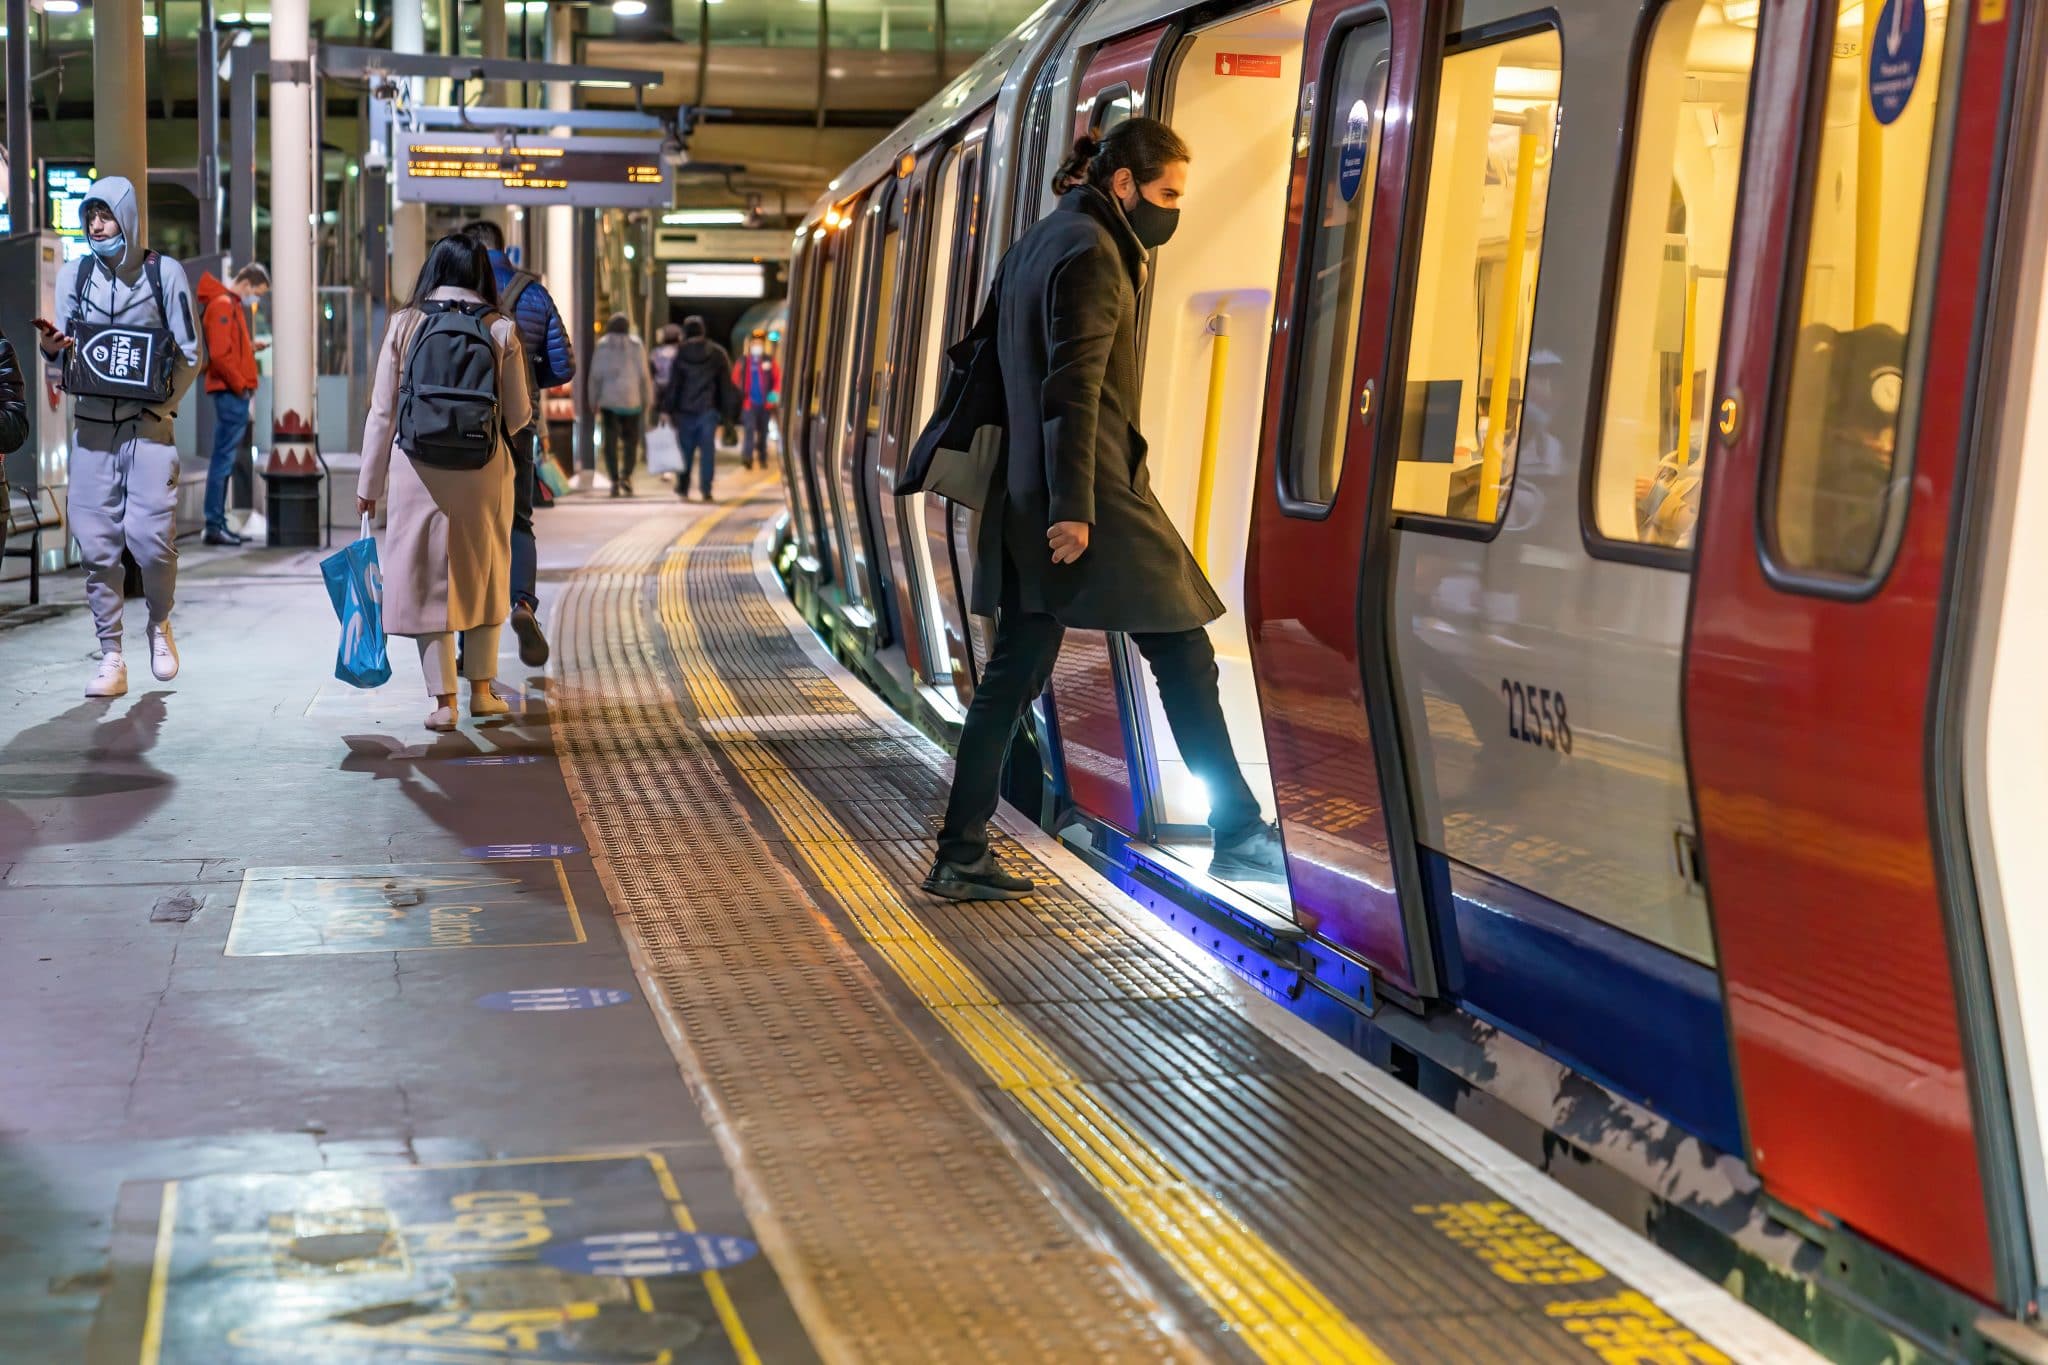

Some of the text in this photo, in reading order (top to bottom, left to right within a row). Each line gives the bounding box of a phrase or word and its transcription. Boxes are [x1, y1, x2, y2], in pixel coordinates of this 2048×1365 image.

[115, 336, 131, 377] KING
[1502, 678, 1572, 755] 22558
[430, 906, 487, 946] Caution
[1411, 1201, 1606, 1284] MIND
